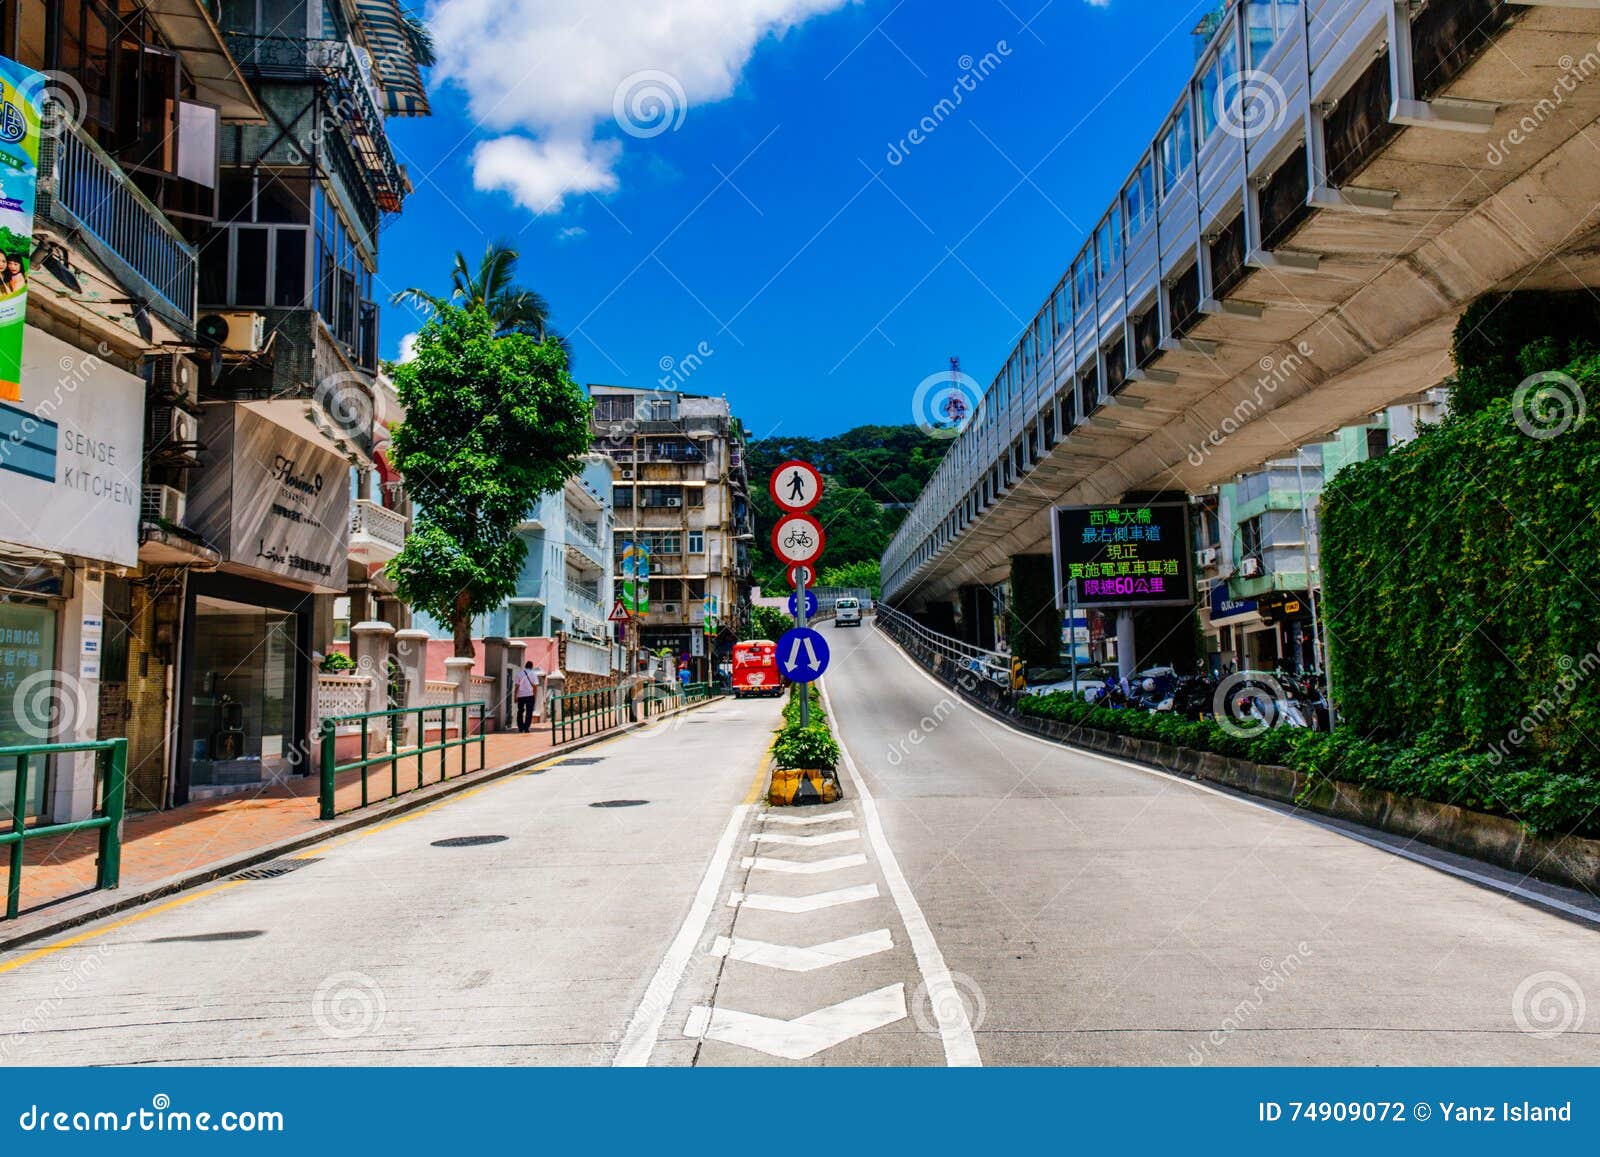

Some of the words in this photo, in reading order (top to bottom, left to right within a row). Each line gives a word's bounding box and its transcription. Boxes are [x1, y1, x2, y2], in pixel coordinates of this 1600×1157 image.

[65, 430, 115, 466] SENSE
[64, 466, 132, 505] KITCHEN
[1089, 508, 1152, 525] 西灣大橋
[1082, 525, 1161, 543] 最右側車道
[1106, 543, 1138, 560] 現正
[1069, 560, 1179, 579] 實施電單車專道
[1084, 577, 1165, 596] 限速60公里
